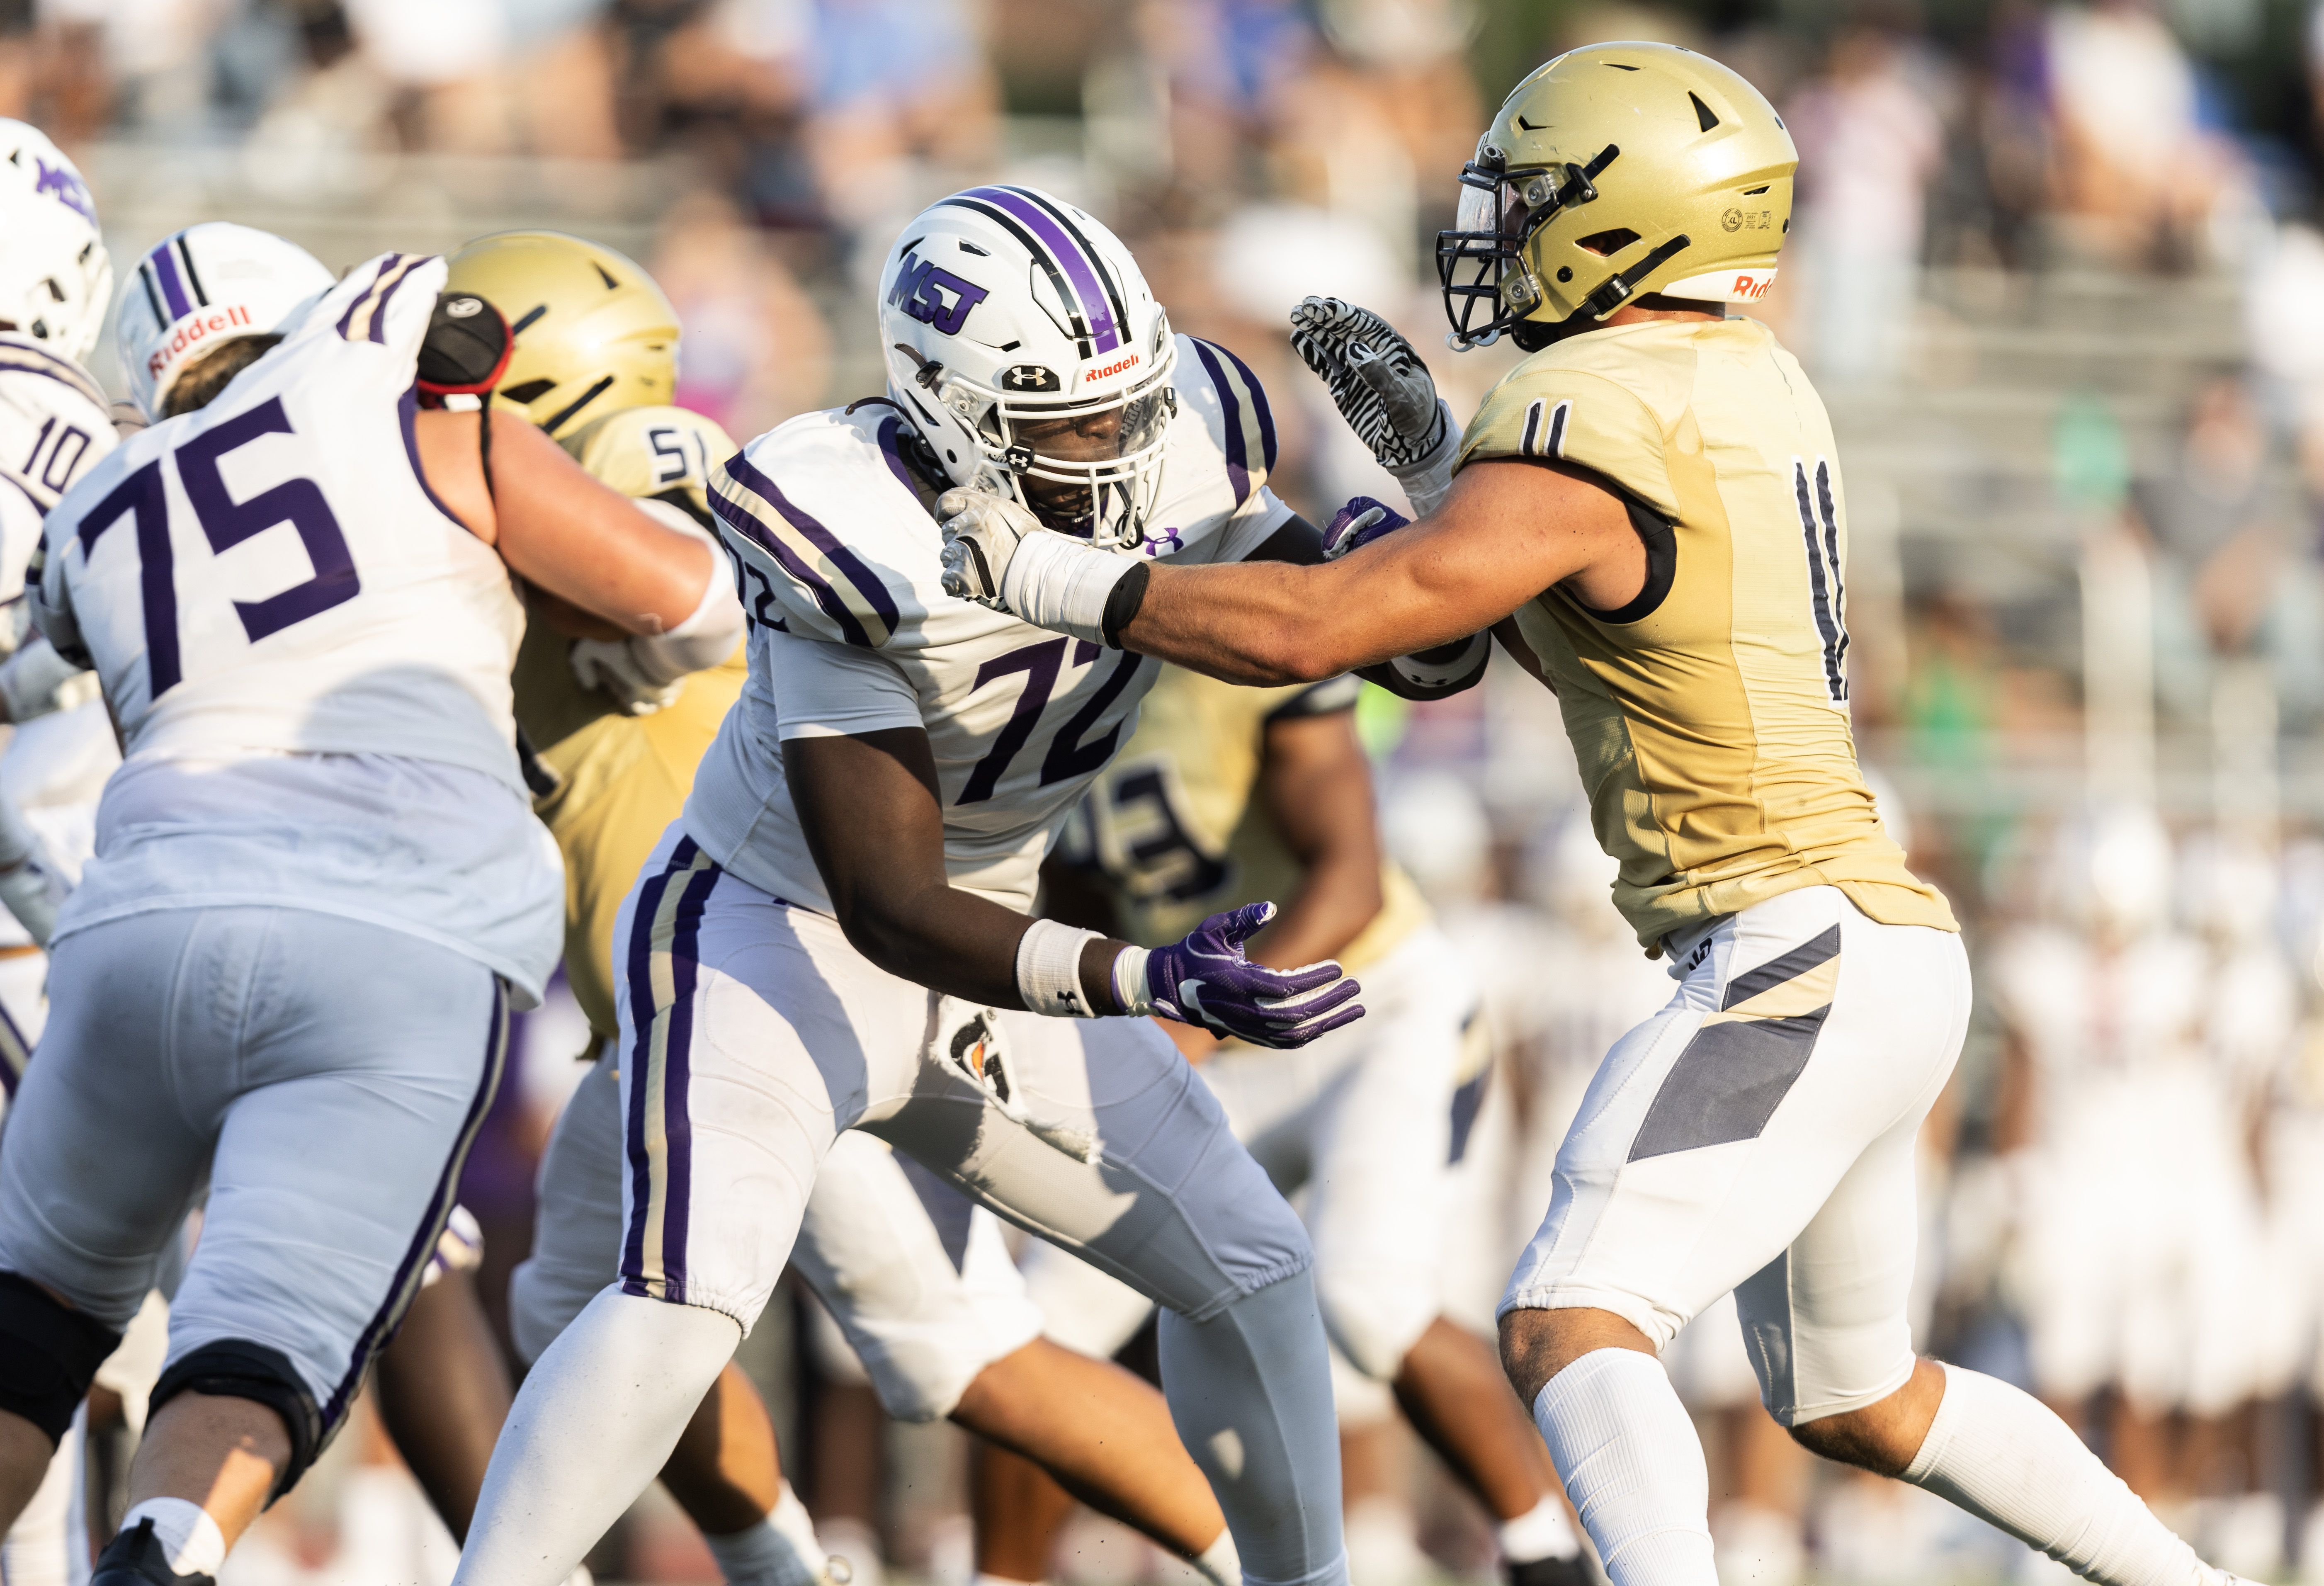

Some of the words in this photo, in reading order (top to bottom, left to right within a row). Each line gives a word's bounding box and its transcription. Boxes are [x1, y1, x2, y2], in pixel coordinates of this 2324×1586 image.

[888, 251, 990, 336] MSJ
[148, 306, 252, 381] Riddell
[1086, 353, 1139, 382] Riddell
[22, 416, 91, 494] 10
[648, 427, 709, 483] 51
[1519, 397, 1574, 458] 11
[78, 394, 361, 701] 75
[1791, 454, 1850, 707] 11
[954, 635, 1143, 806] 72
